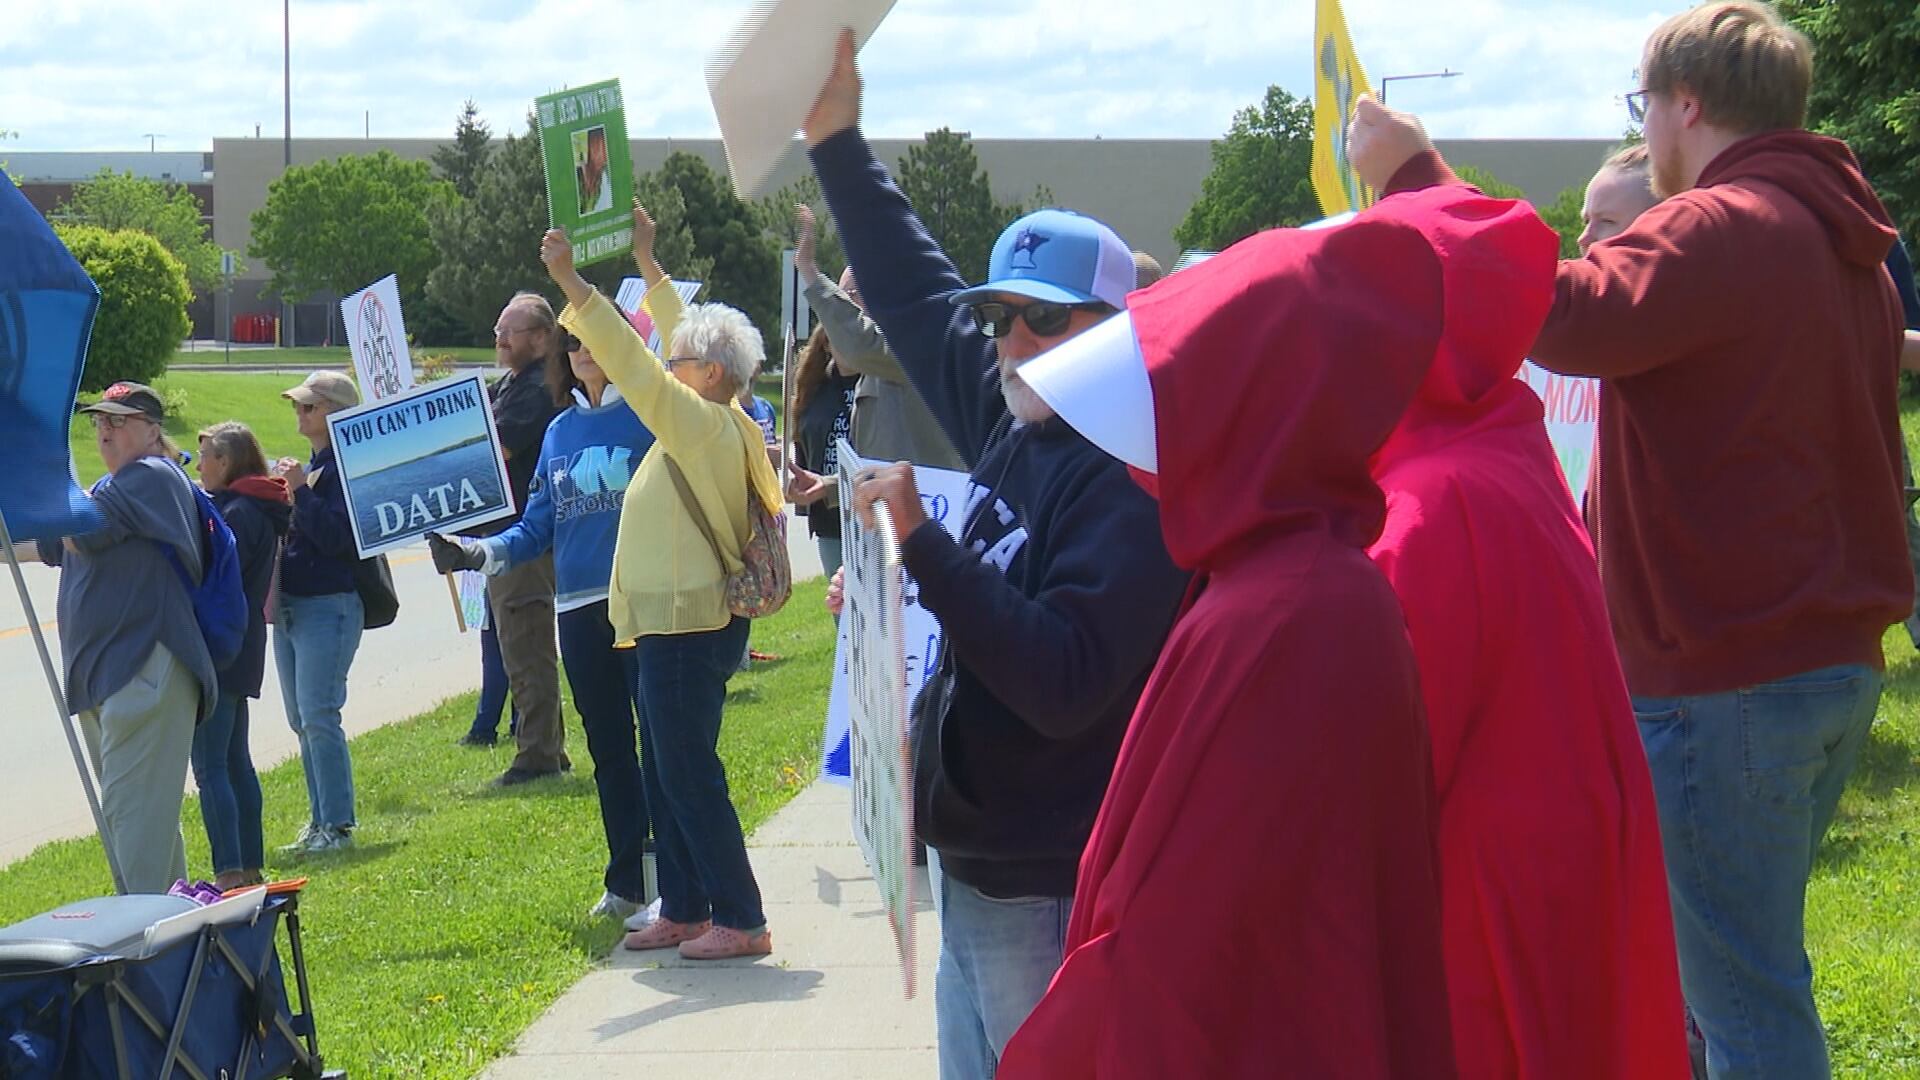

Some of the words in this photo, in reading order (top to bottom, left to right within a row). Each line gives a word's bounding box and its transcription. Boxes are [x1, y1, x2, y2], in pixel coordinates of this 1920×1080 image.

[362, 299, 383, 338] NO
[362, 335, 397, 375] DATA
[340, 419, 373, 447] YOU
[376, 403, 421, 436] CAN'T
[426, 387, 477, 422] DRINK
[373, 478, 486, 538] DATA
